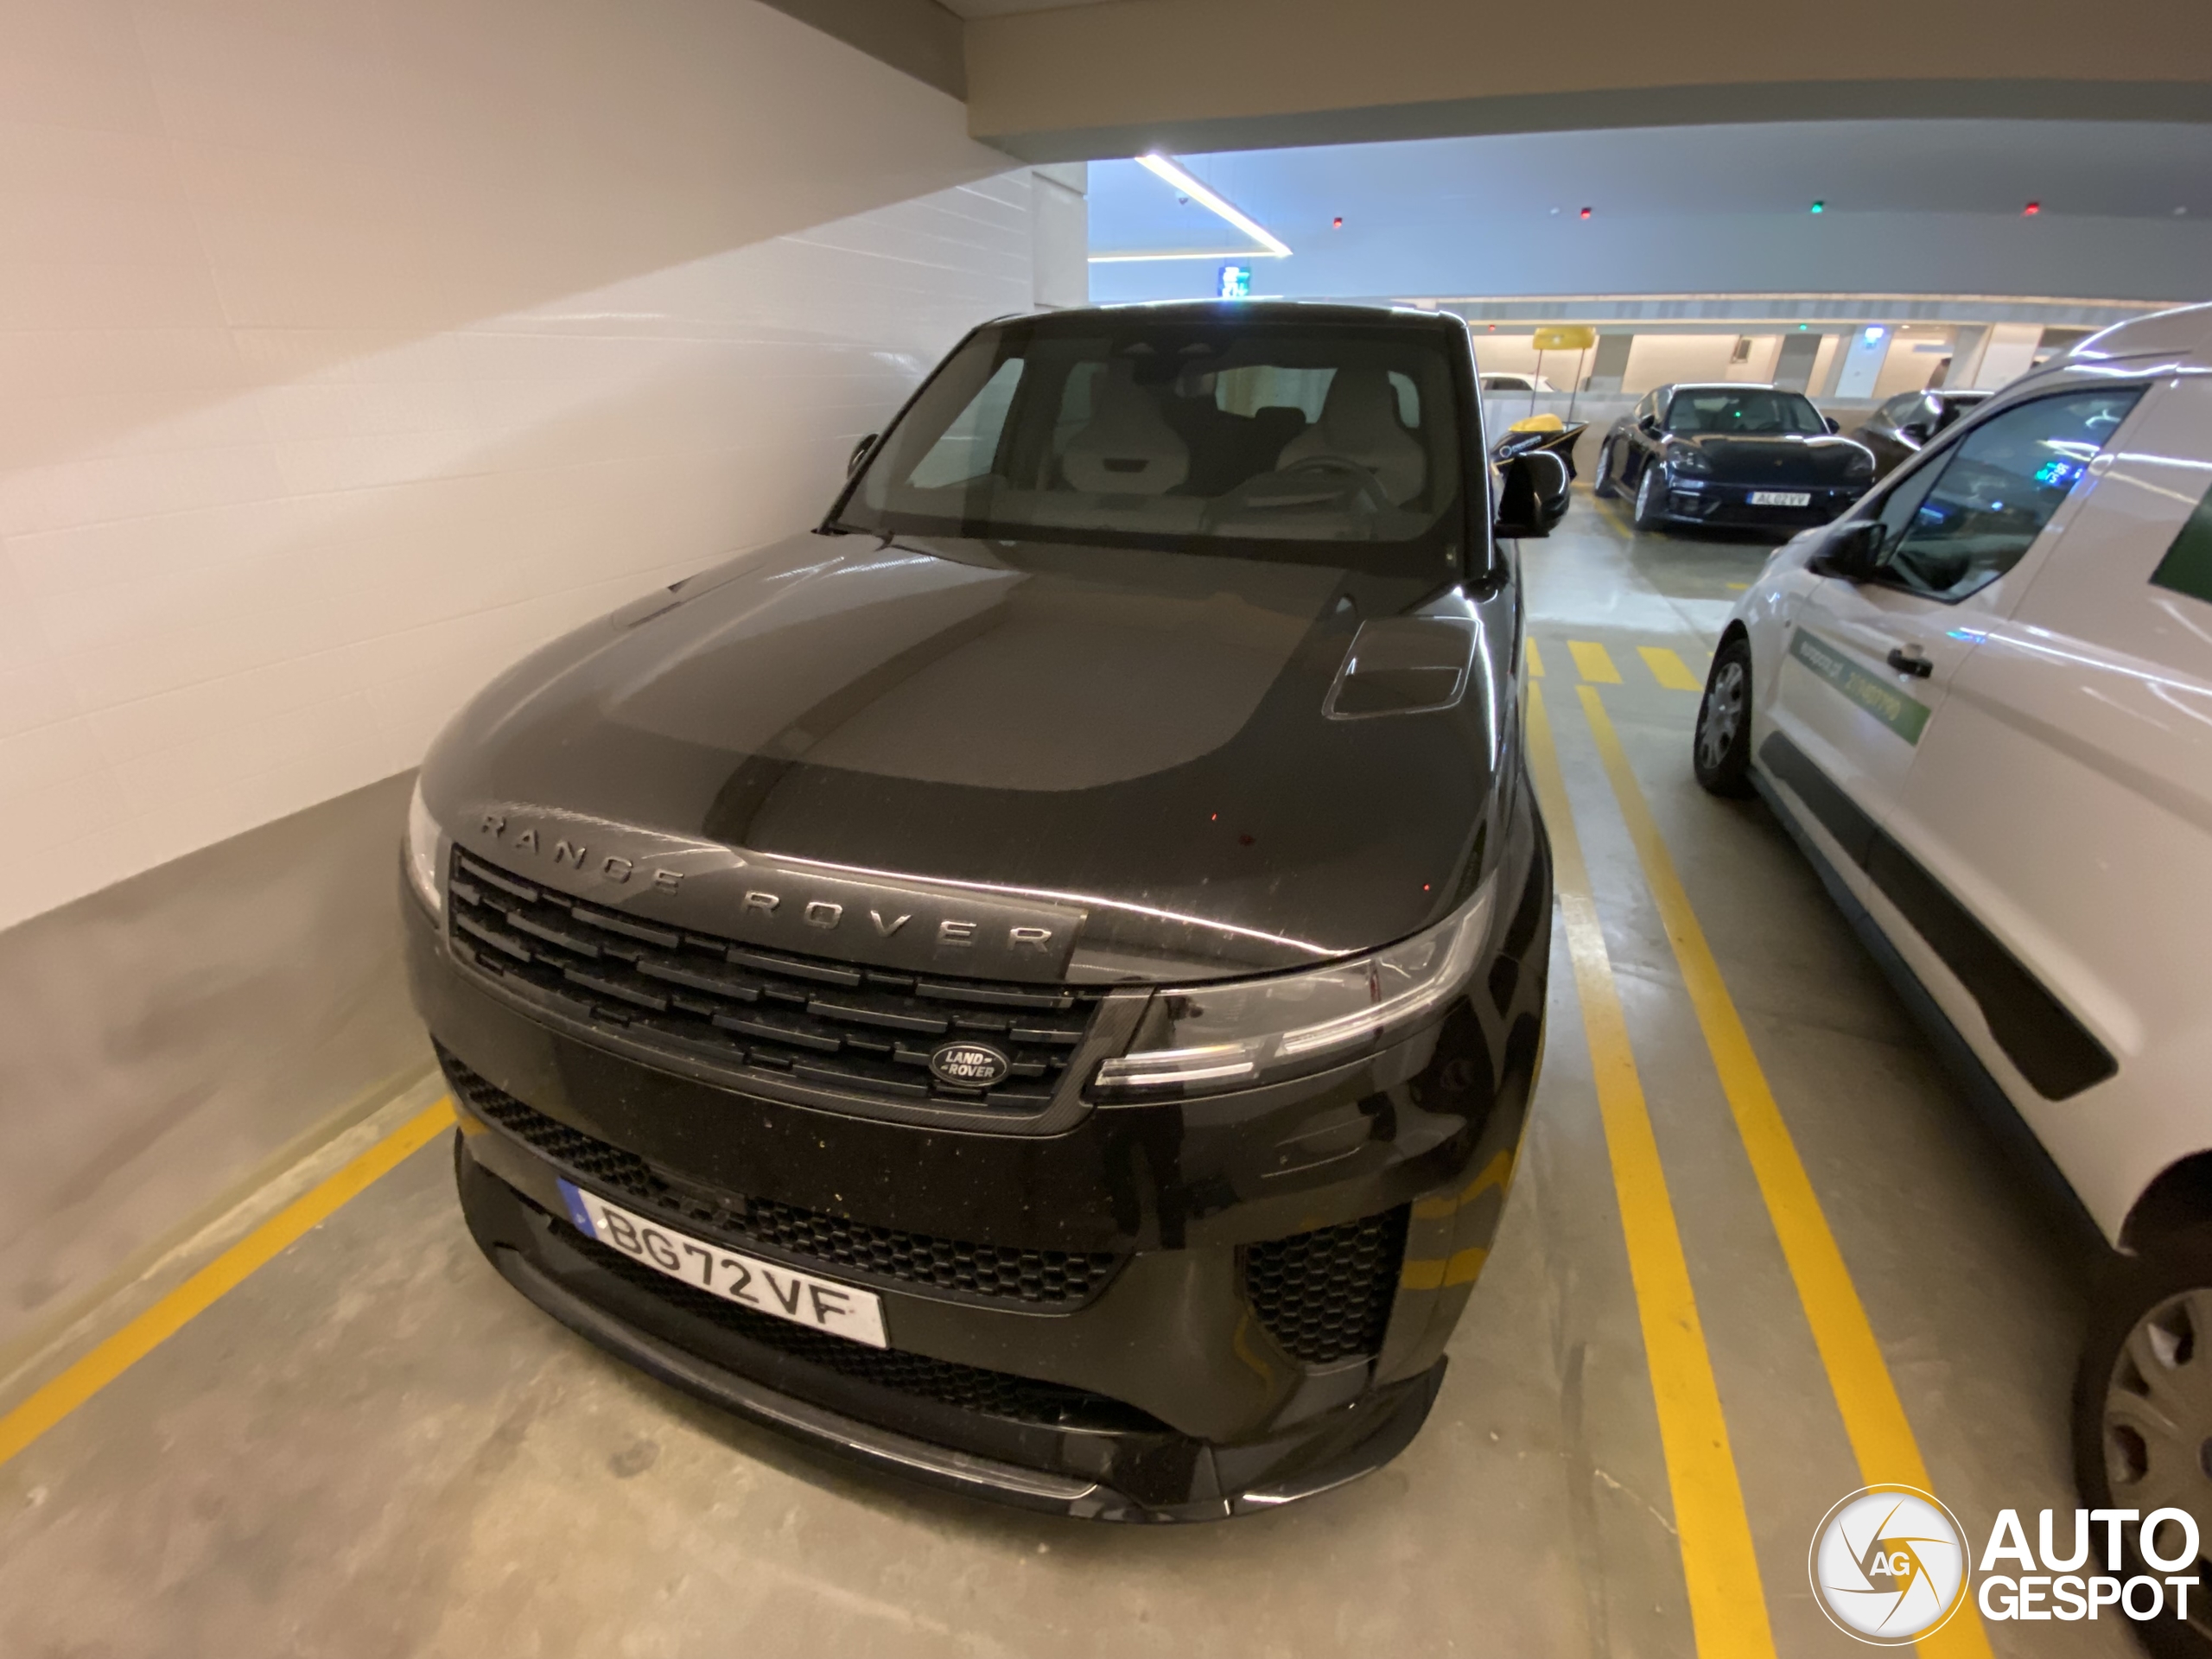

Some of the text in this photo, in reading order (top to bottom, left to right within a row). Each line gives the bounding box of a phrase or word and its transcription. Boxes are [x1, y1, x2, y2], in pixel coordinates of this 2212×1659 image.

[480, 814, 1052, 951] RANGE ROVER
[945, 1051, 984, 1065] LAND
[948, 1064, 995, 1077] ROVER
[601, 1205, 851, 1325] BG72VF
